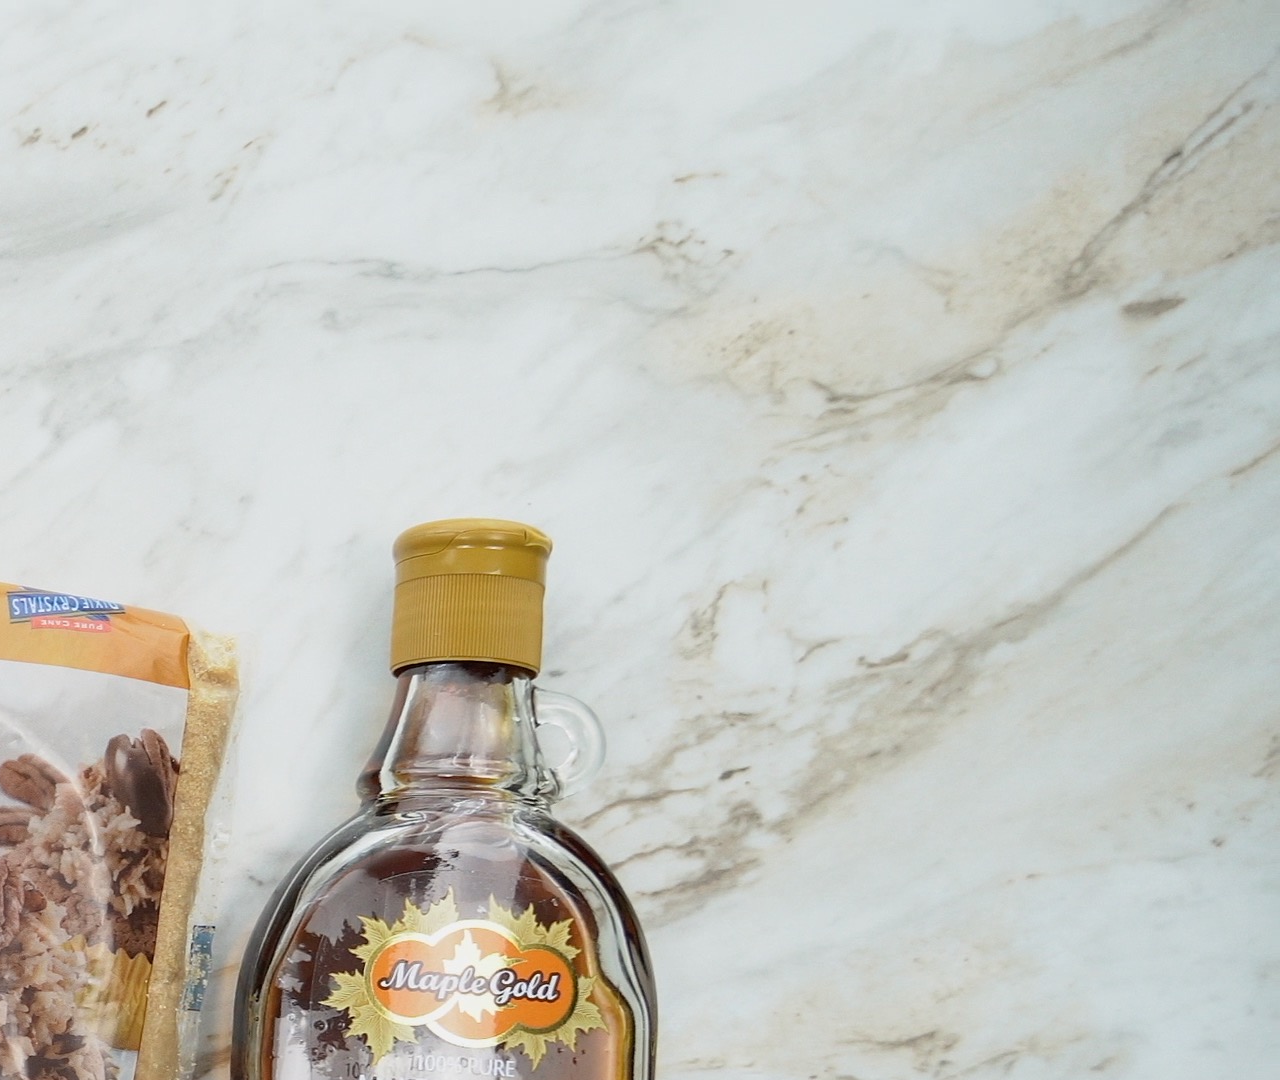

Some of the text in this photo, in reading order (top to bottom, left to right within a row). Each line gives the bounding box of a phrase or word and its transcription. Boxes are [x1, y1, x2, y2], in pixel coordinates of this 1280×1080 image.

[12, 596, 79, 615] CRYSTALS
[74, 622, 104, 631] PURE
[378, 960, 560, 1005] Maple Gold
[468, 1058, 516, 1078] PURE
